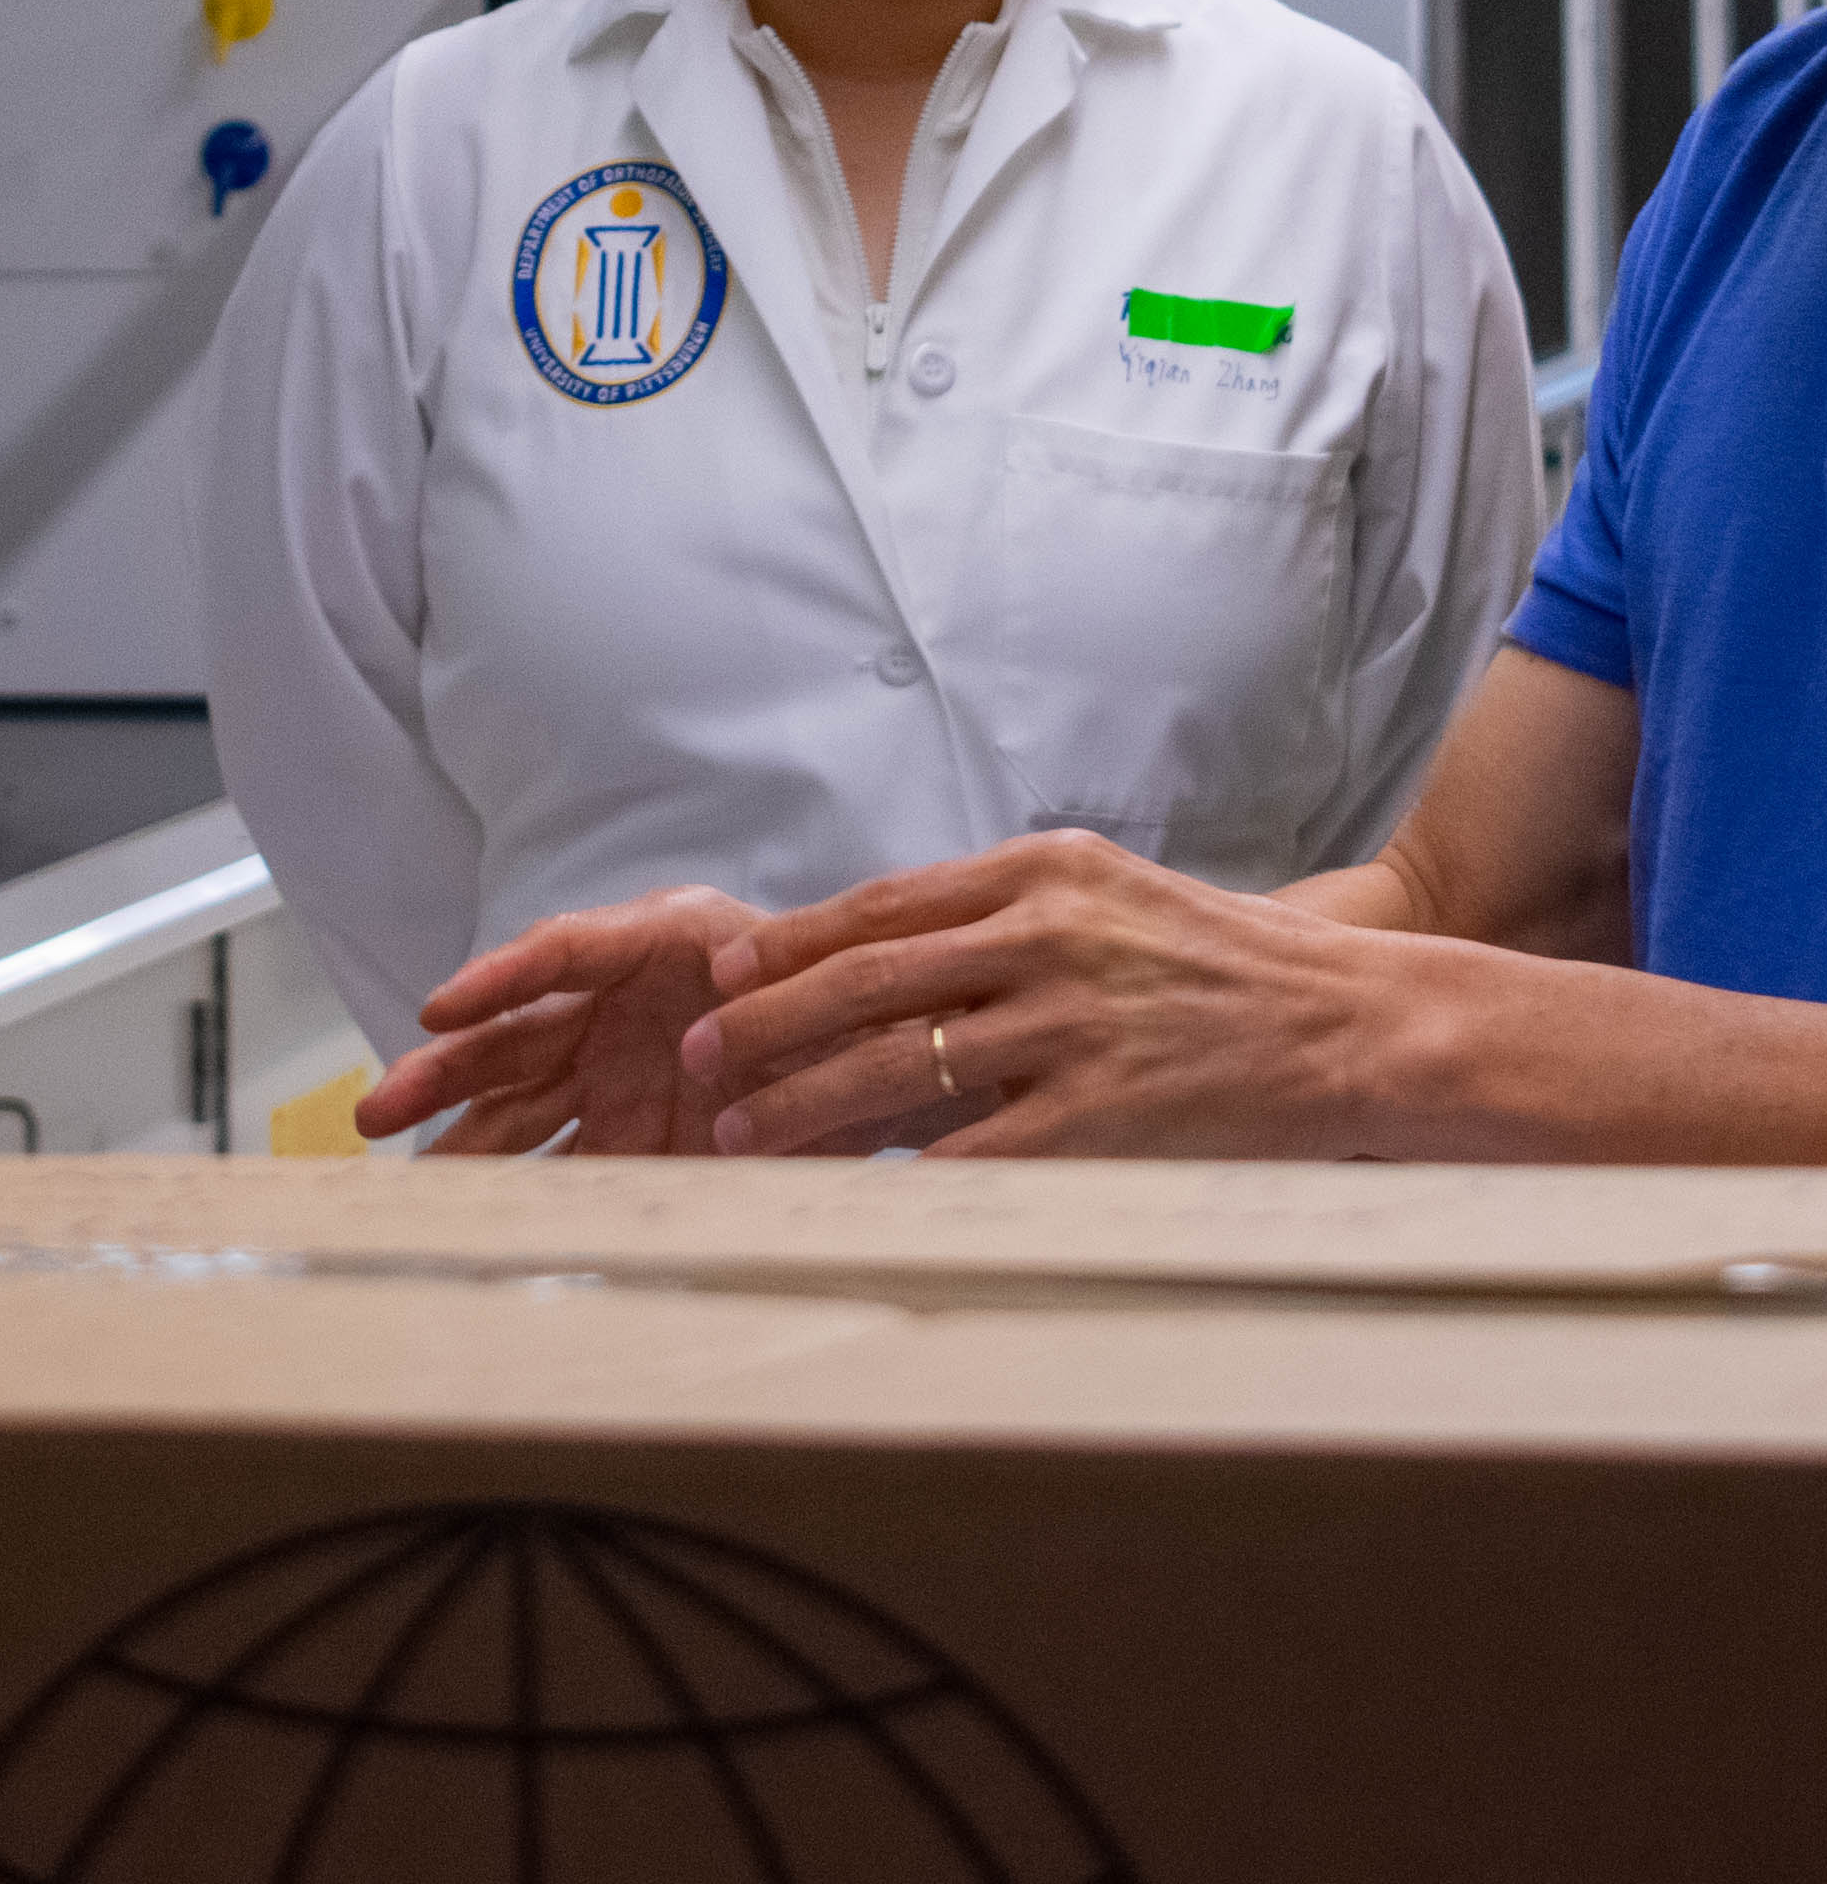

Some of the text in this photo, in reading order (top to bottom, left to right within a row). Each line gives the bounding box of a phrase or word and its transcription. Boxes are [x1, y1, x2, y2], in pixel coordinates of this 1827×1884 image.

[517, 185, 575, 280] DEPARTMENT
[577, 172, 597, 193] OF
[525, 320, 711, 402] UNIVERSITY OF PITTSBURGH
